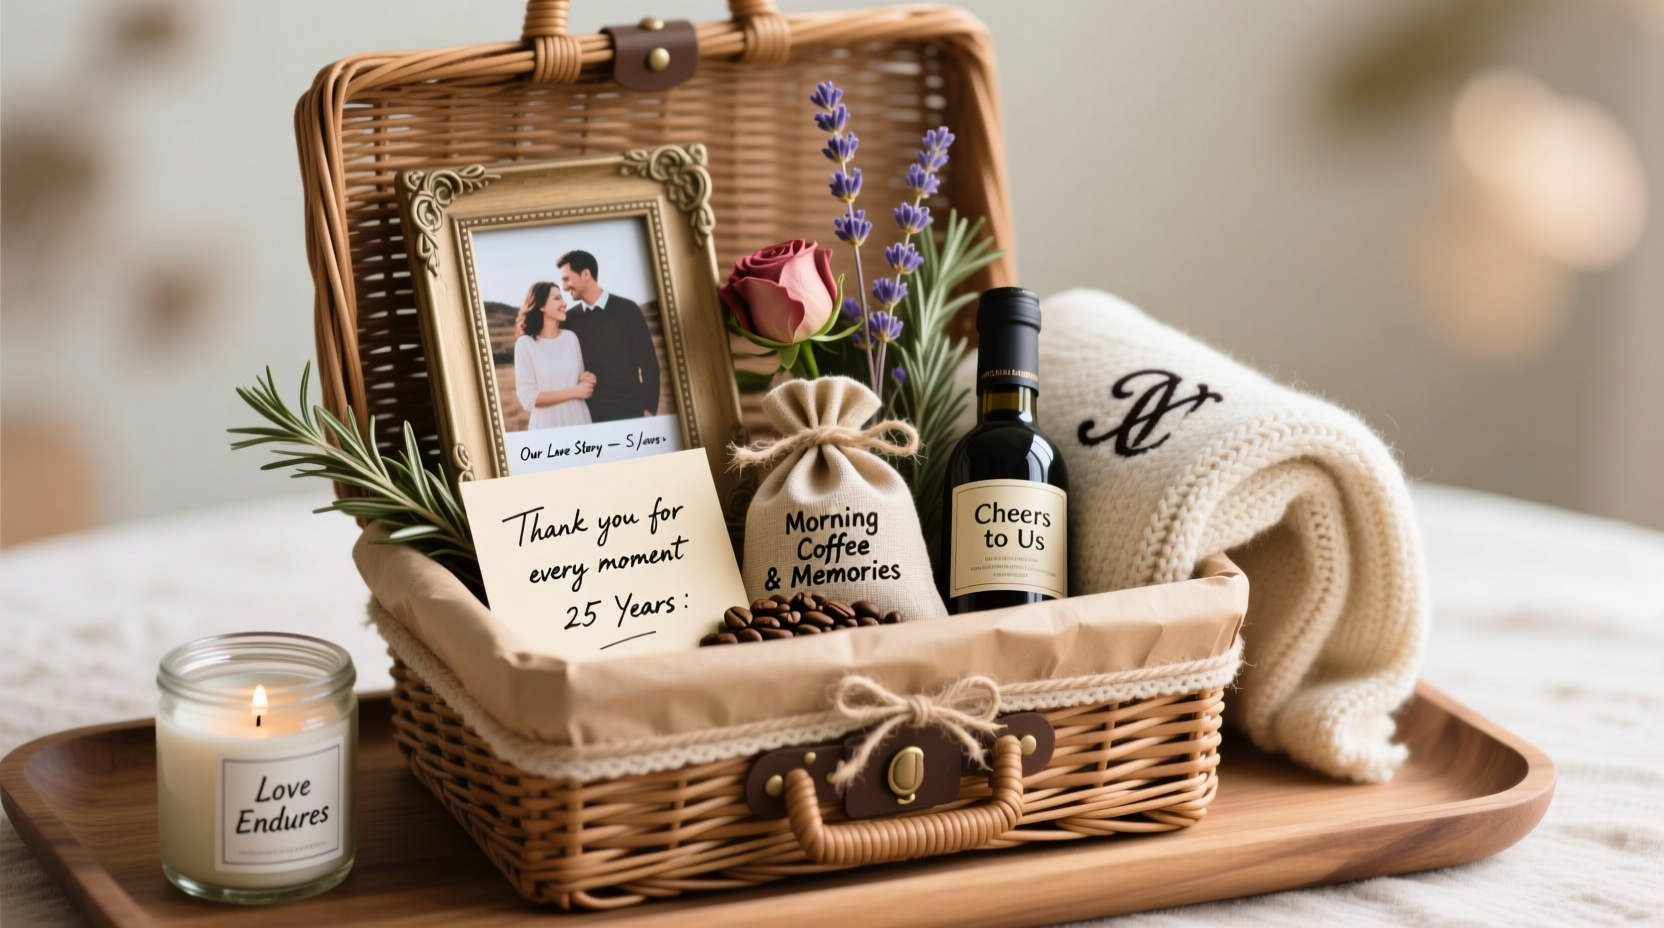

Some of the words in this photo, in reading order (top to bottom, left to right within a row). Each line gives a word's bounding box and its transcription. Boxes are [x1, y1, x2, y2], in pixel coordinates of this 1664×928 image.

[520, 446, 543, 461] Our
[502, 506, 588, 547] Thank
[597, 512, 640, 547] you
[648, 496, 684, 535] for
[785, 506, 879, 536] Morning
[974, 501, 1051, 528] Cheers
[797, 532, 870, 565] Coffee
[984, 529, 1008, 549] to
[1018, 528, 1045, 551] Us
[529, 563, 590, 593] every
[598, 535, 690, 573] moment
[764, 566, 782, 591] &
[790, 559, 902, 589] Memories
[563, 600, 602, 630] 25
[254, 775, 311, 803] Love
[235, 805, 329, 835] Endures
